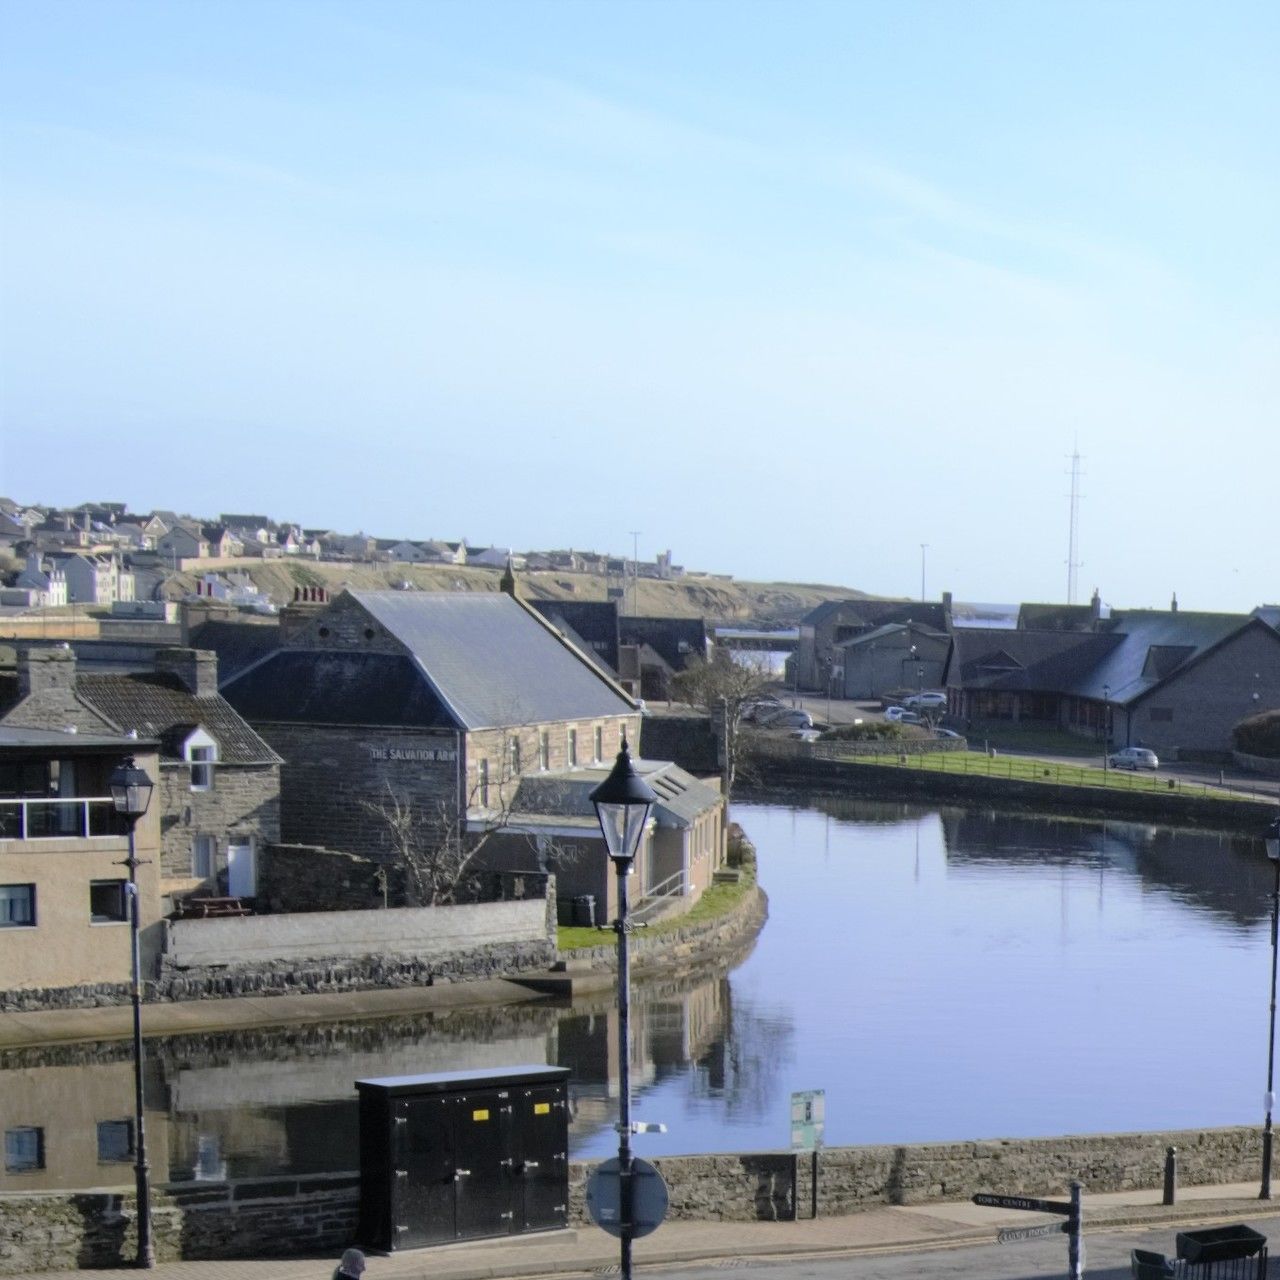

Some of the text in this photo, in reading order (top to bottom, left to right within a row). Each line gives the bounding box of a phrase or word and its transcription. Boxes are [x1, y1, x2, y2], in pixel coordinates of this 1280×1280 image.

[371, 747, 387, 760] THE
[389, 748, 435, 761] SALVATION
[977, 1195, 999, 1205] TOWN
